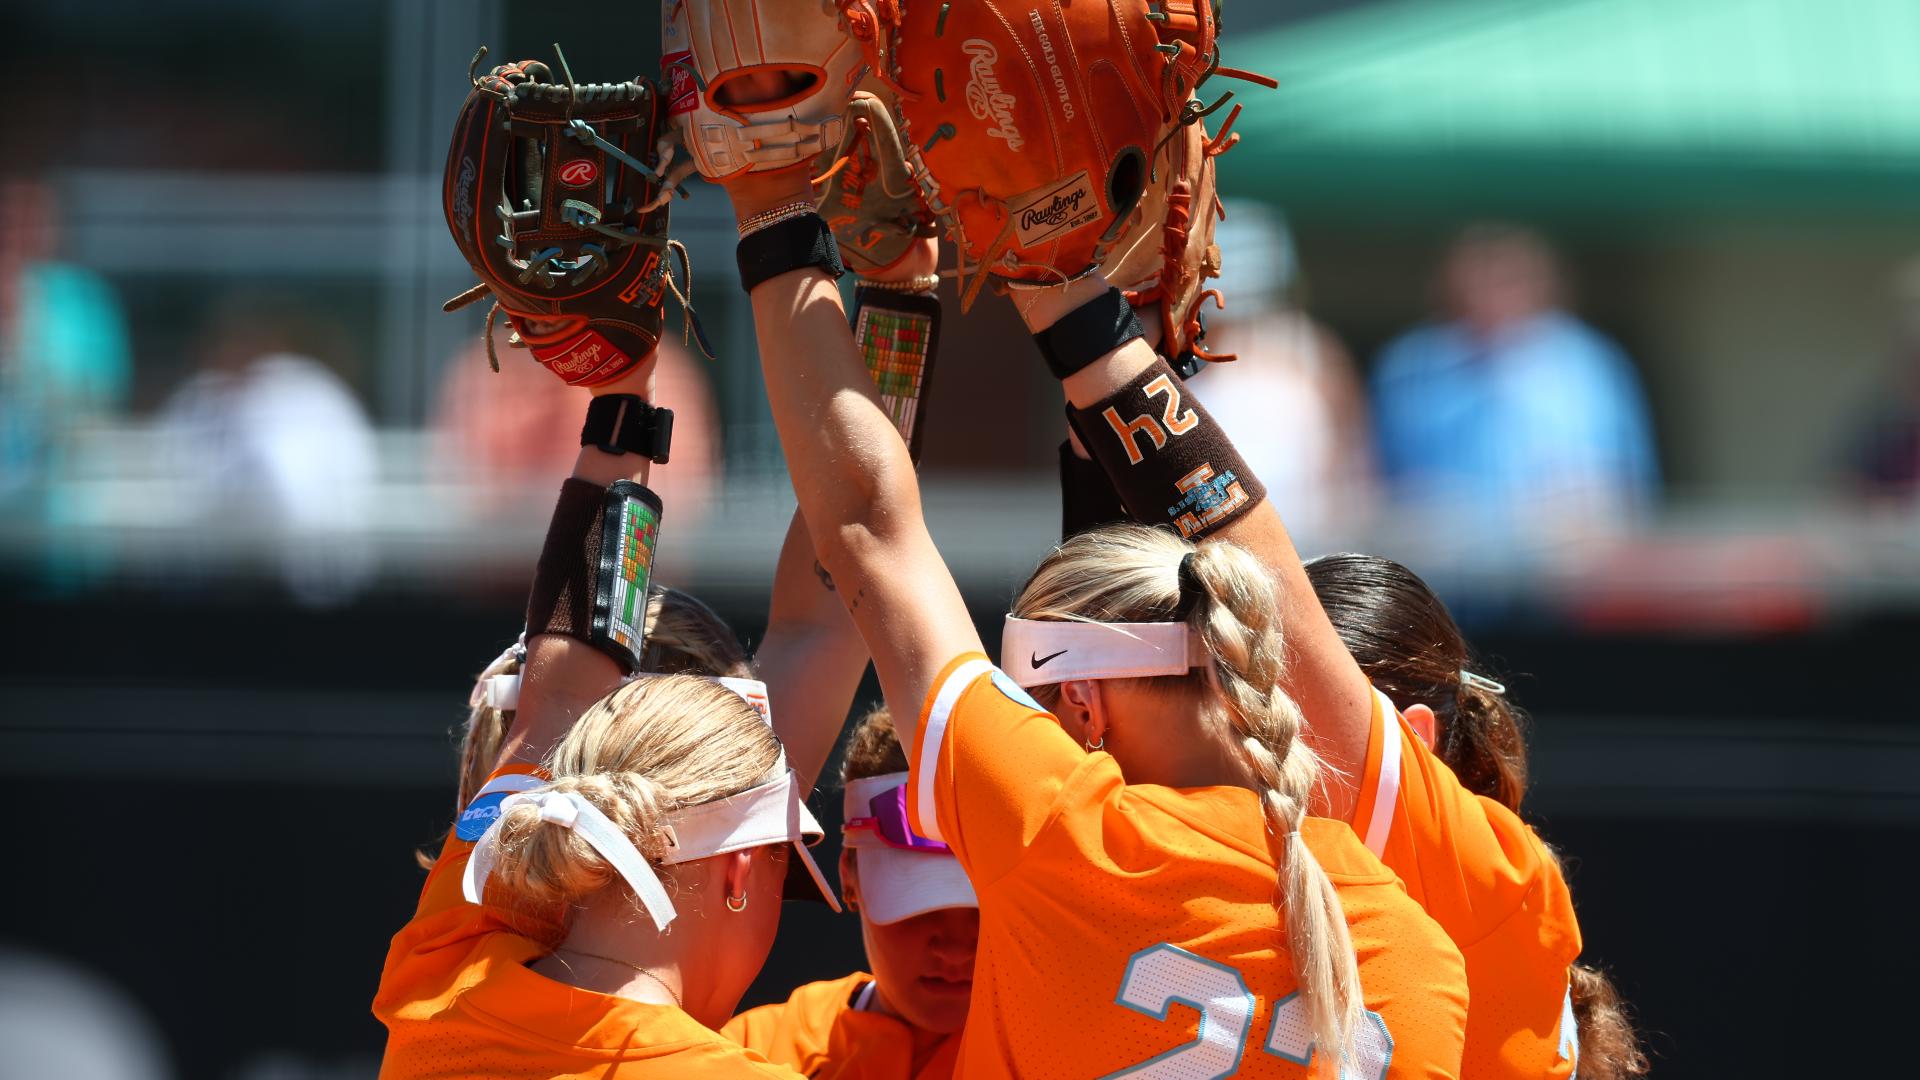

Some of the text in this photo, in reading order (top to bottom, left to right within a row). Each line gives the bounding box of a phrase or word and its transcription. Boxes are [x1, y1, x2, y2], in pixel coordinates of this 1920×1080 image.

[962, 38, 1024, 153] Rawlings
[1029, 8, 1075, 123] THE GOLD GLOVE CO.
[560, 161, 594, 184] R
[1021, 188, 1087, 231] Rawlings
[551, 343, 602, 375] Rawlings
[1102, 373, 1199, 466] 24
